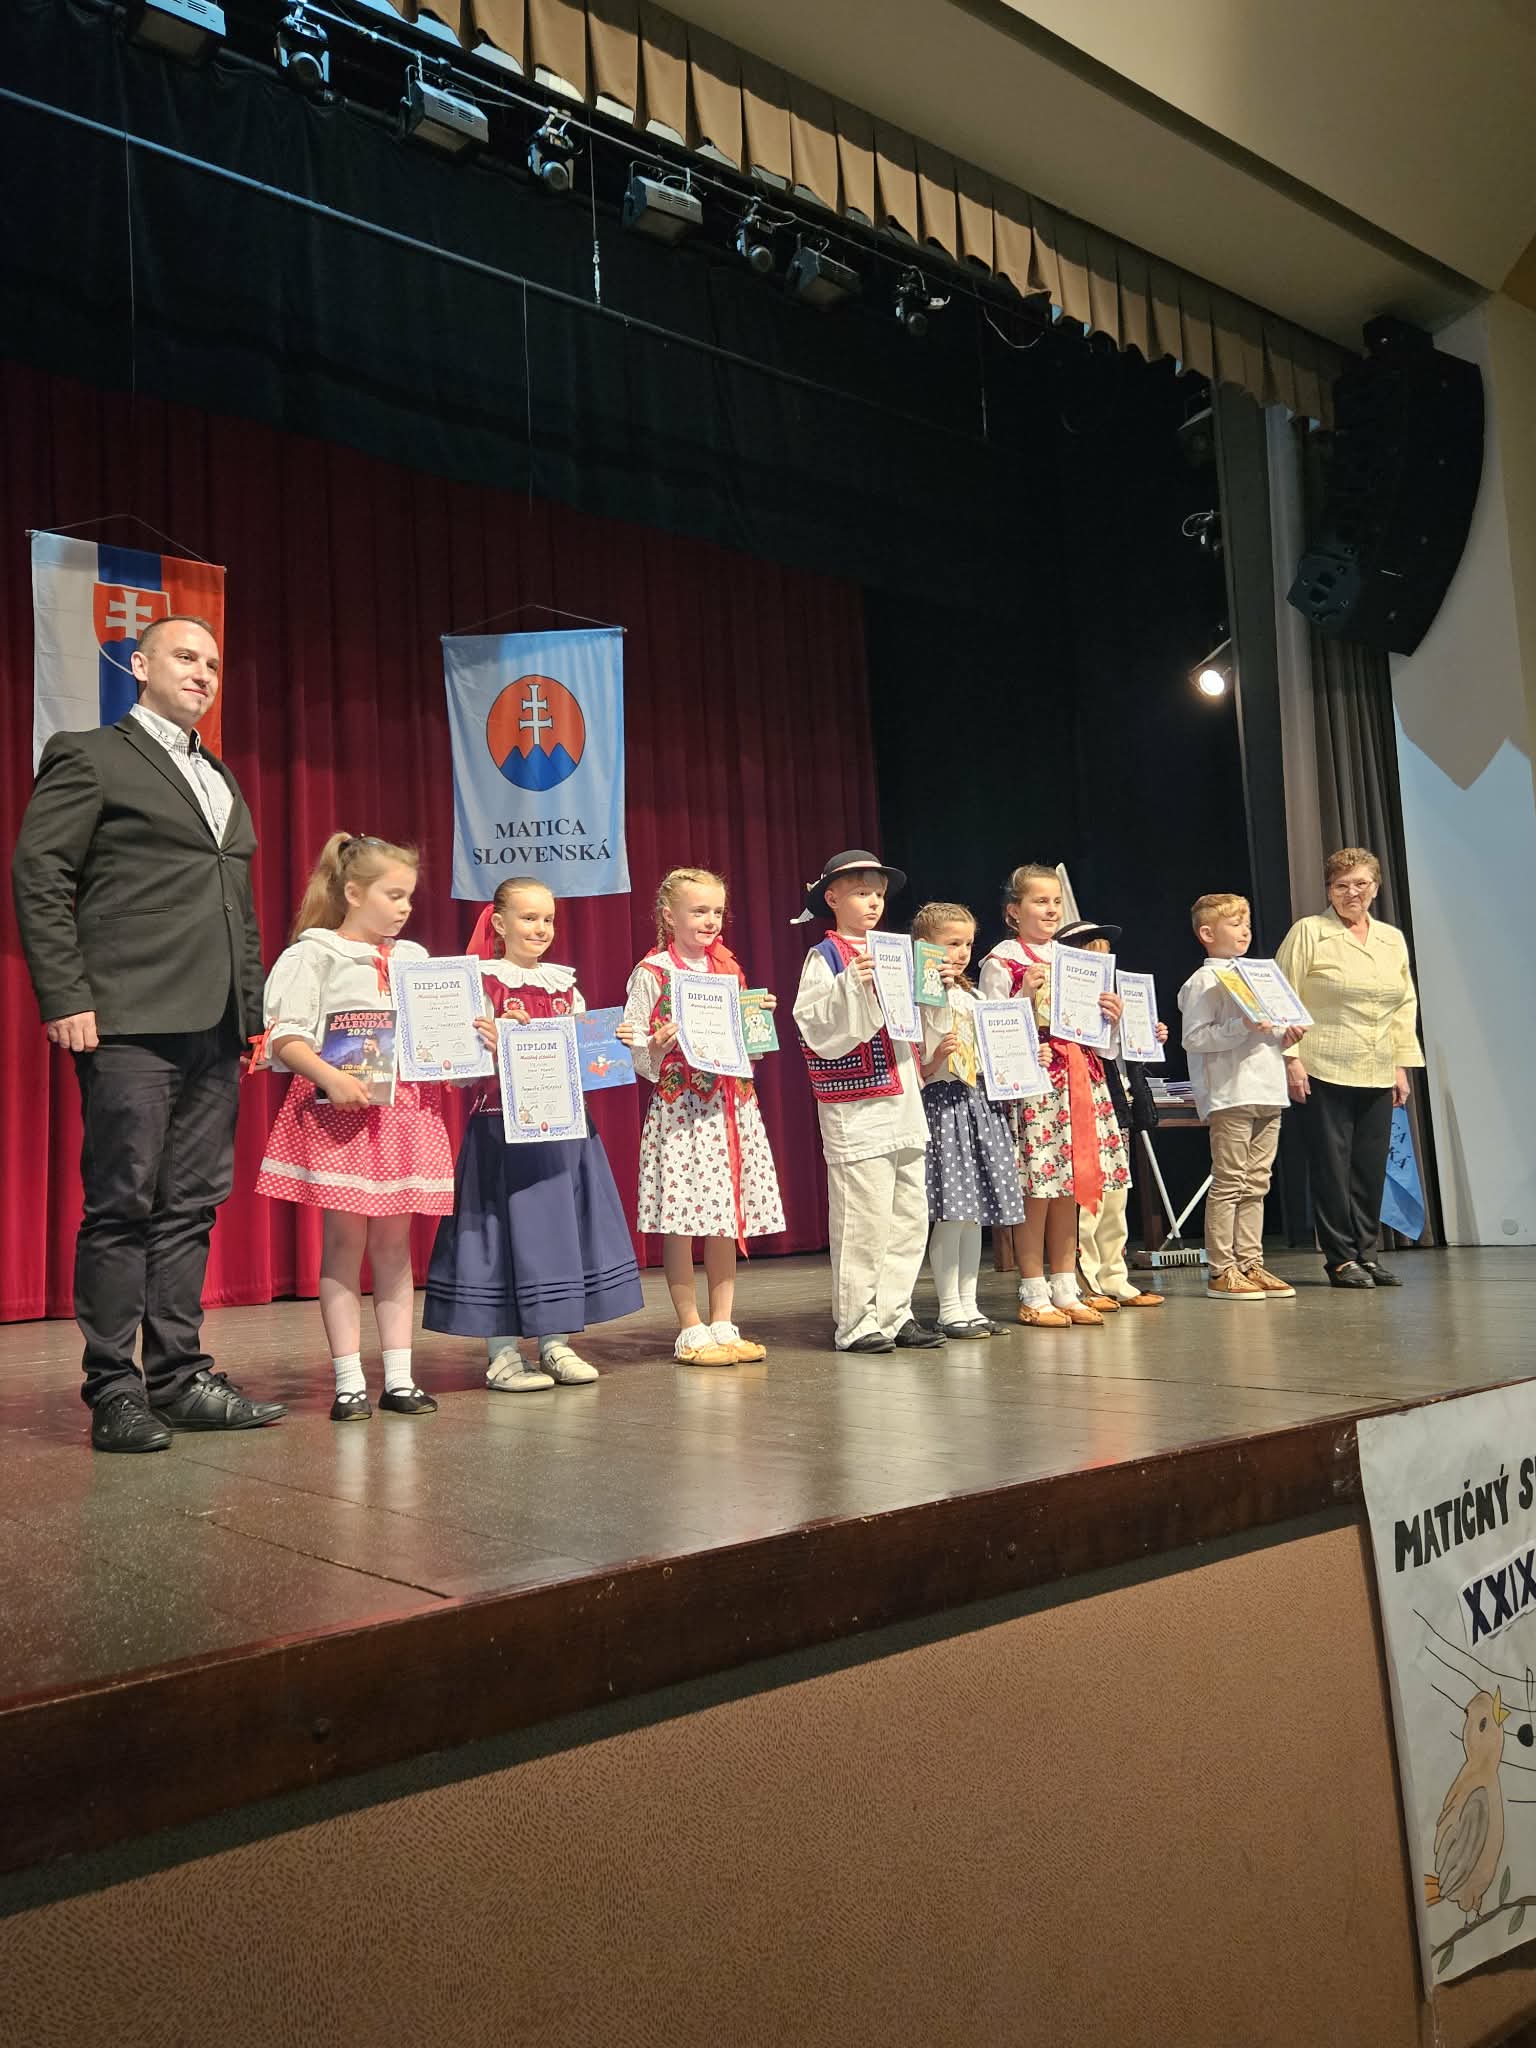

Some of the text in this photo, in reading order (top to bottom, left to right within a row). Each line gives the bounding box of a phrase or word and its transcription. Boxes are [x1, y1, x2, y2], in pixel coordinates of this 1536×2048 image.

[495, 818, 587, 839] MATICA
[472, 838, 612, 866] SLOVENSKÁ
[1066, 965, 1097, 978] DIPLOM
[413, 981, 461, 990] DIPLOM
[687, 992, 723, 1003] DIPLOM
[988, 1018, 1019, 1027] DIPLOM
[346, 1028, 374, 1036] 2026
[516, 1042, 558, 1052] DIPLOM
[1394, 1456, 1536, 1573] MATIČNÝ S
